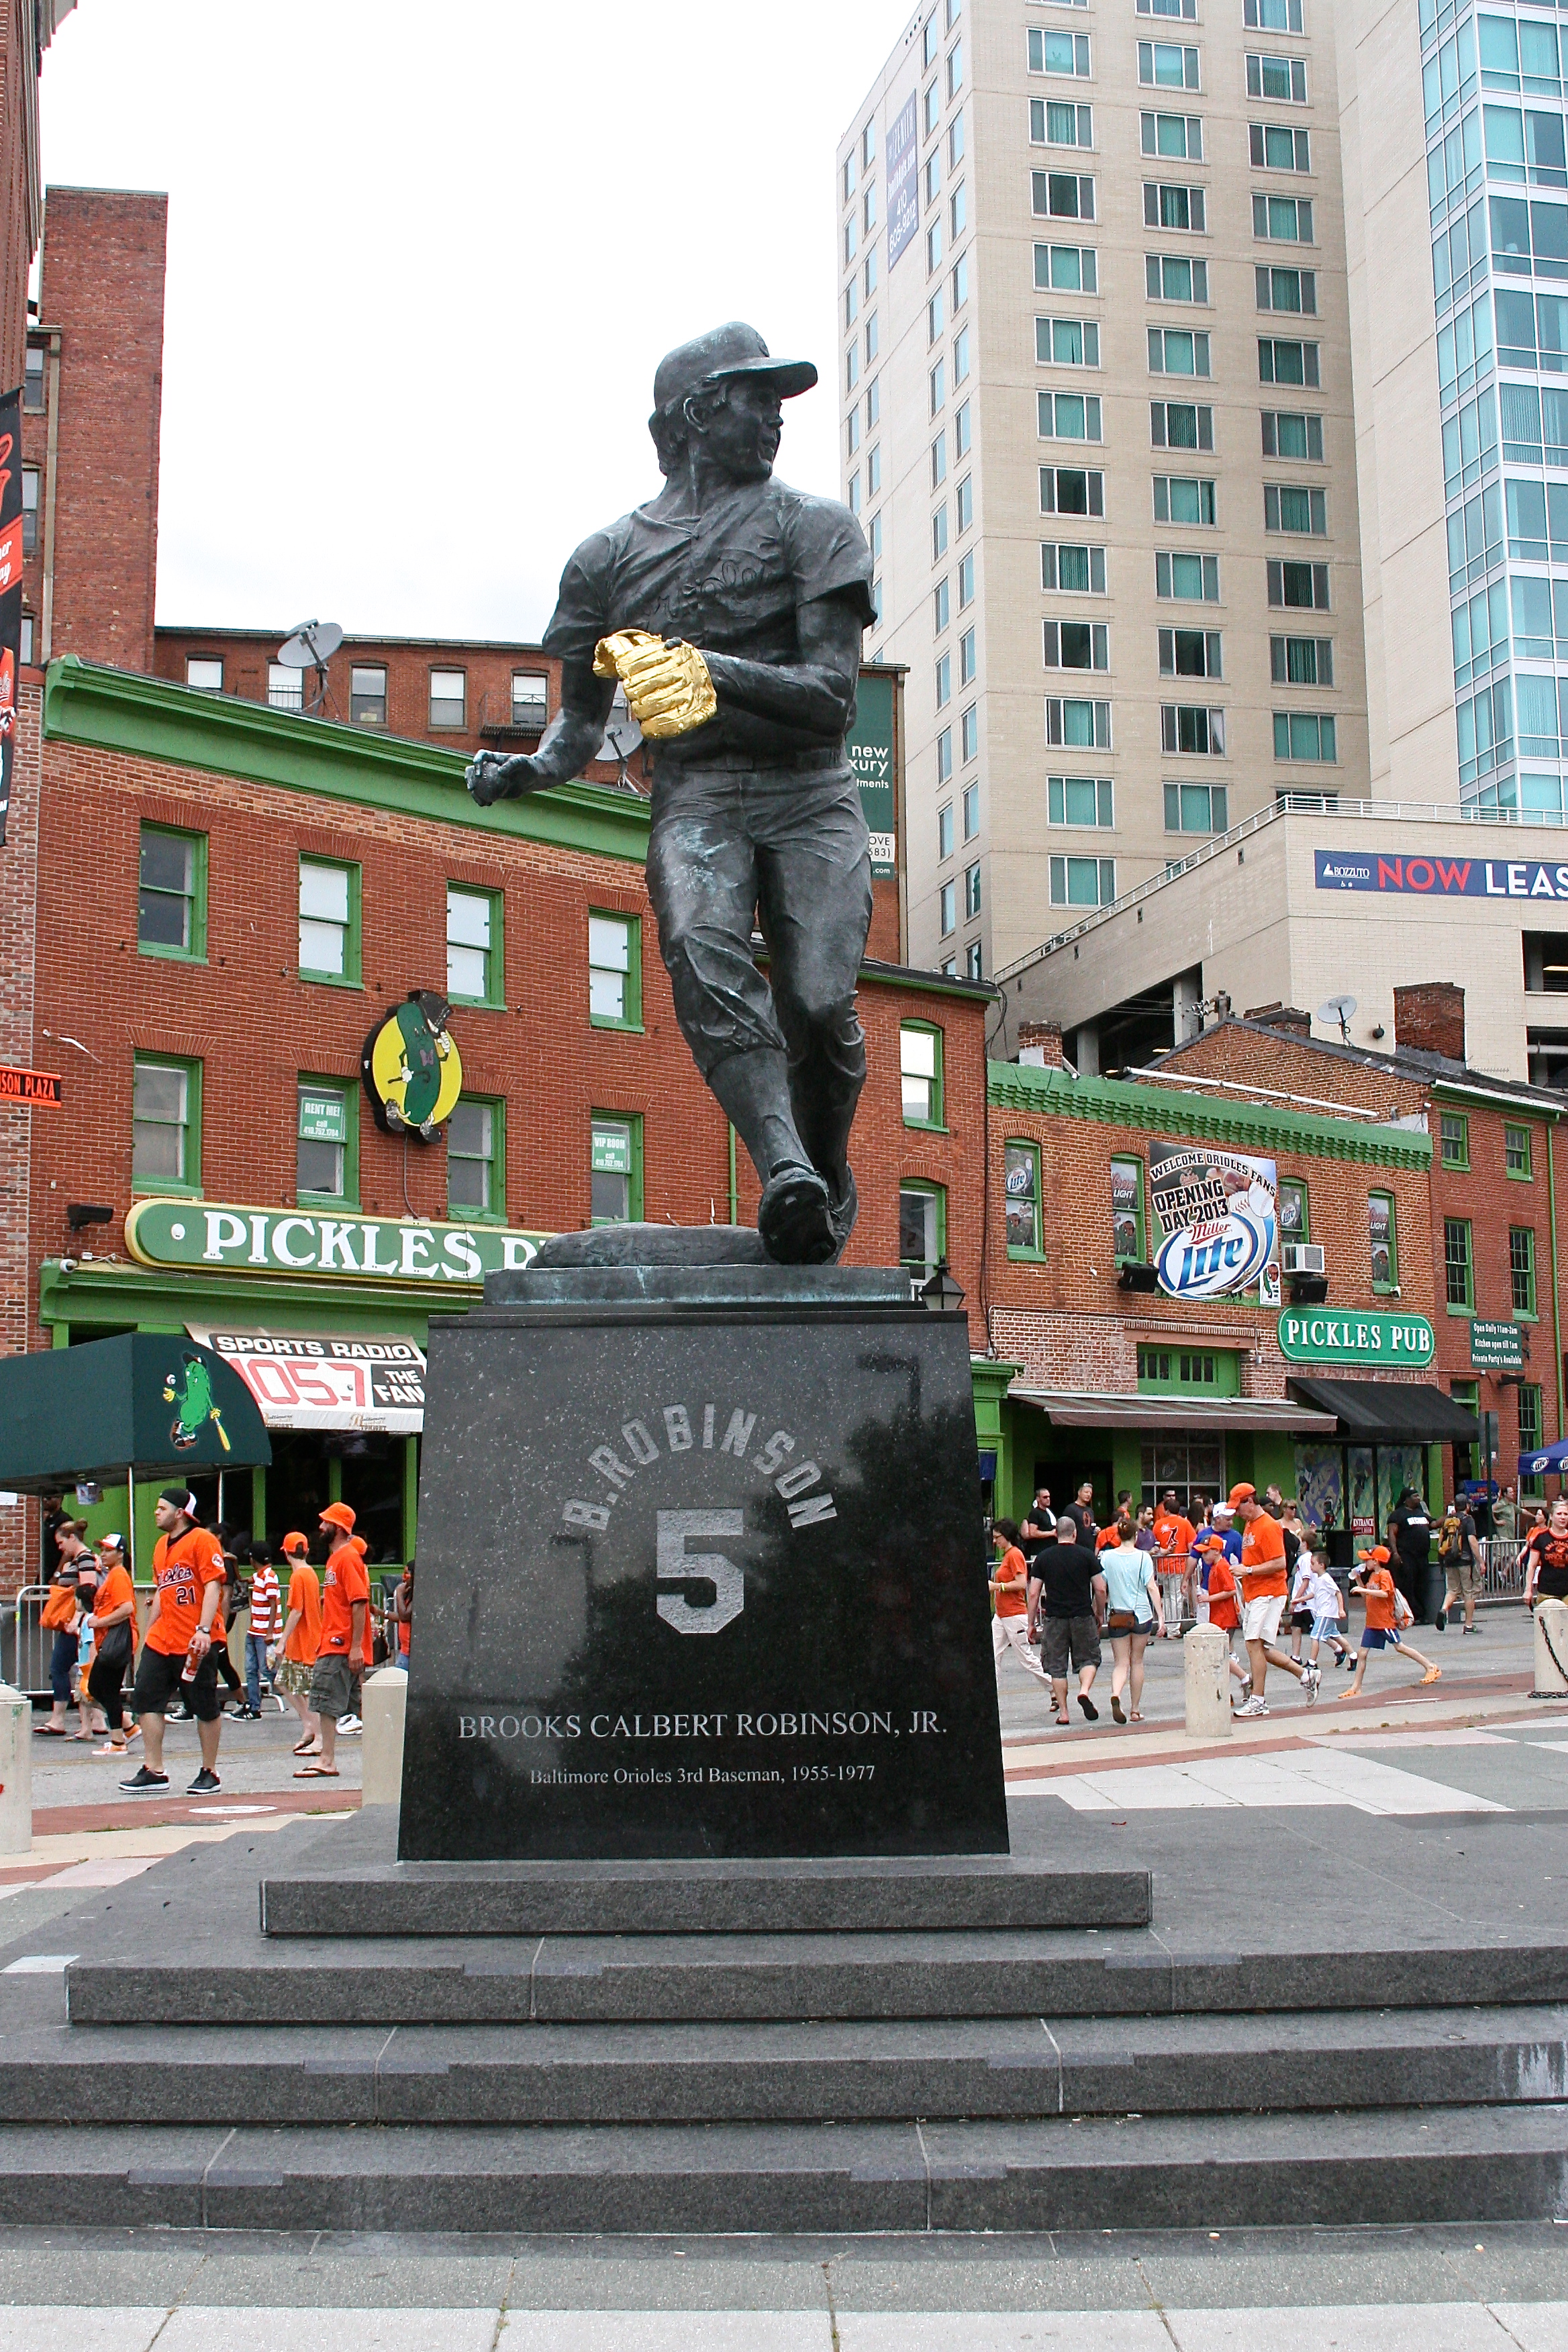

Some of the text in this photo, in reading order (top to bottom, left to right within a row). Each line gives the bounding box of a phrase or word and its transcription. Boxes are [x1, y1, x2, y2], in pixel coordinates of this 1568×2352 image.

[897, 189, 908, 216] 410
[889, 199, 917, 254] 605-9212
[852, 745, 889, 758] new
[848, 759, 889, 777] xury
[856, 779, 889, 789] tments
[869, 836, 890, 846] OVE
[869, 848, 891, 859] 683)
[1334, 866, 1370, 878] BOZZUTO
[1377, 857, 1568, 898] NOW LEAS
[0, 1072, 55, 1099] SON PLAZA
[305, 1103, 326, 1115] RENT
[594, 1136, 625, 1149] VIP ROOM
[1010, 1175, 1025, 1190] Lite
[1150, 1153, 1276, 1197] WELCOME ORIOLES FANS
[1114, 1189, 1134, 1199] LIGHT
[1154, 1179, 1224, 1212] OPENING
[1161, 1198, 1229, 1233] DAY 2013
[1371, 1222, 1387, 1230] LIGHT
[1186, 1221, 1232, 1242] Miller
[203, 1212, 483, 1279] PICKLES
[1175, 1236, 1245, 1291] Lite
[1286, 1319, 1430, 1352] PICKLES PUB
[216, 1336, 413, 1359] SPORTS RADIO
[385, 1370, 422, 1383] THE
[373, 1384, 426, 1403] FAN
[656, 1508, 744, 1634] 5
[176, 1585, 196, 1606] 21
[458, 1710, 948, 1739] BROOKS CALBERT ROBINSON, JR.
[530, 1765, 875, 1785] Baltimore Orioles 3rd Baseman, 1955-1977
